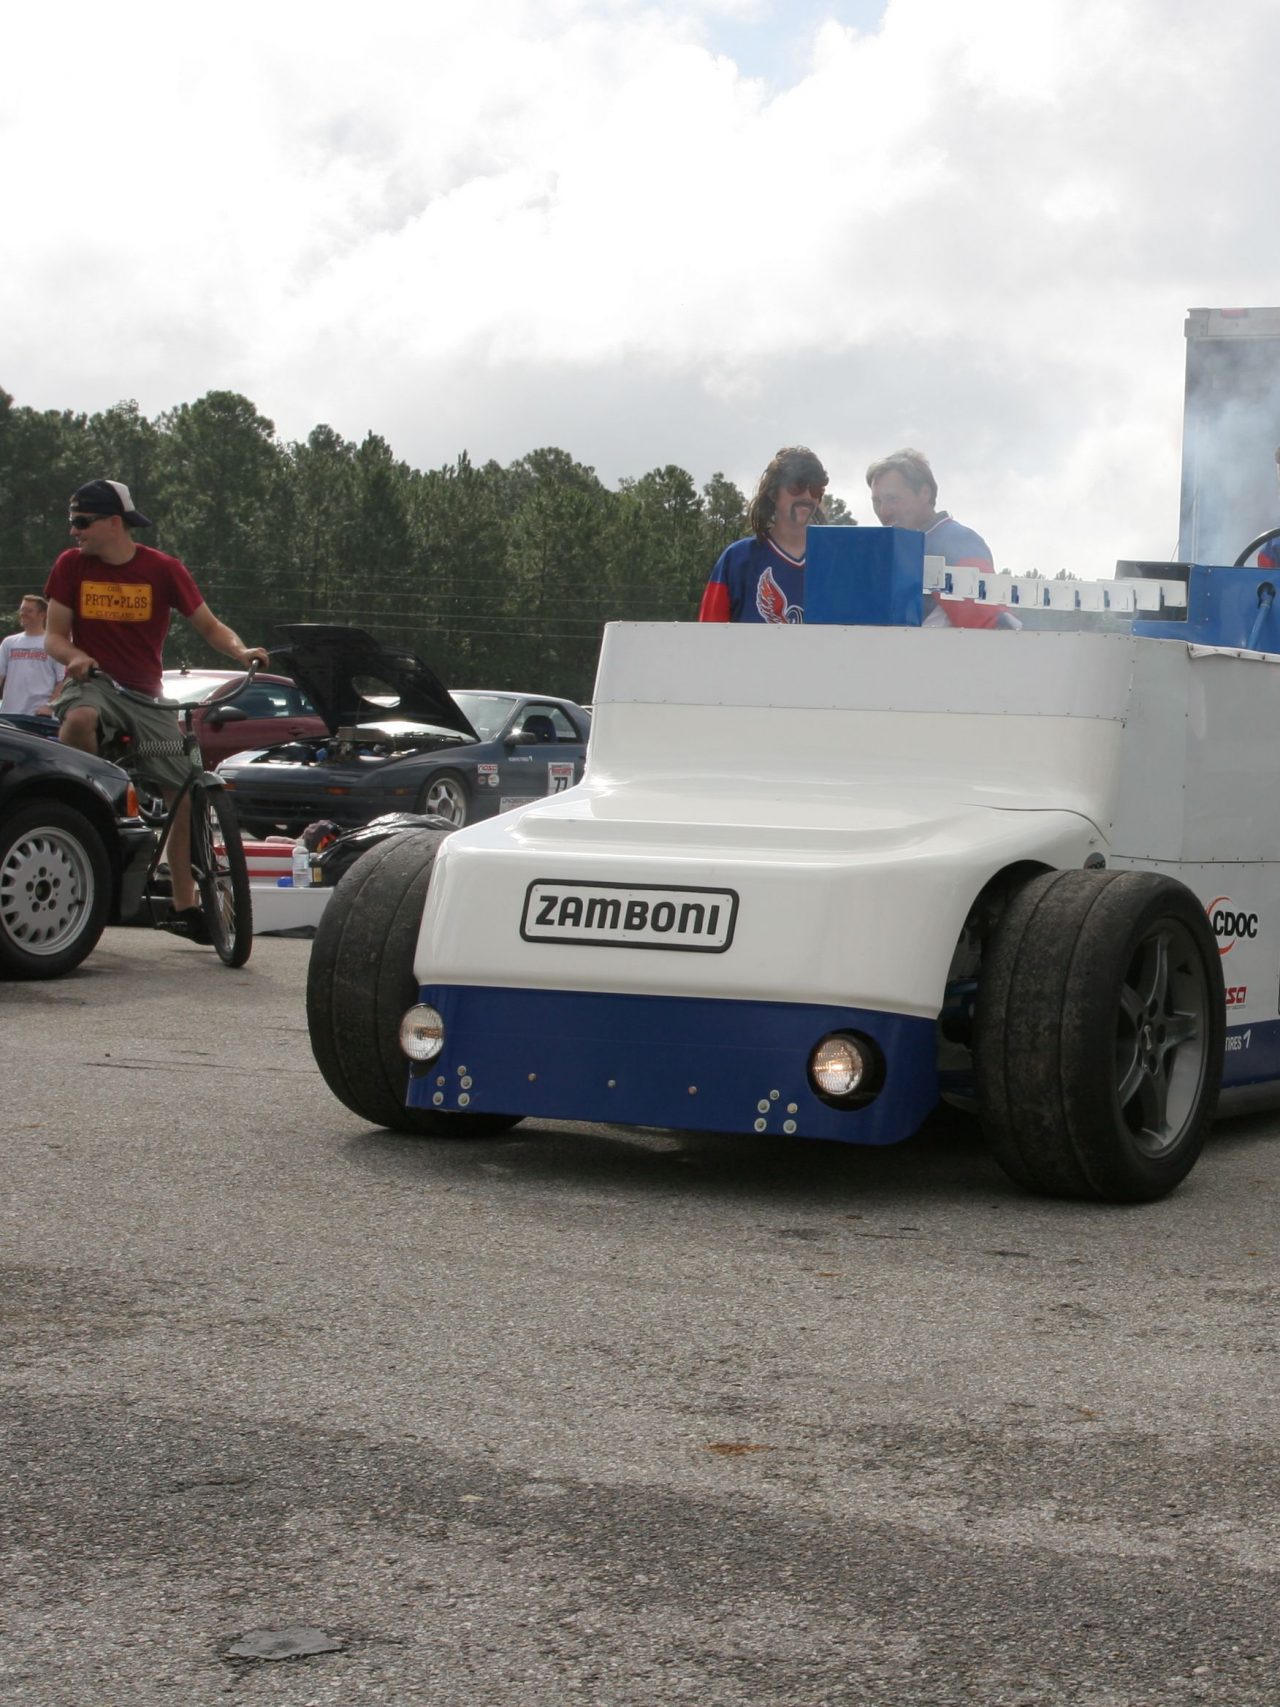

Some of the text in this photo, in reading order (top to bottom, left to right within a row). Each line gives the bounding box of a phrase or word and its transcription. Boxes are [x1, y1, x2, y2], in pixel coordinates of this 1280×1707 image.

[85, 593, 147, 609] PRTY PL8S
[535, 895, 720, 935] ZAMBONI
[1213, 910, 1258, 939] CDOC
